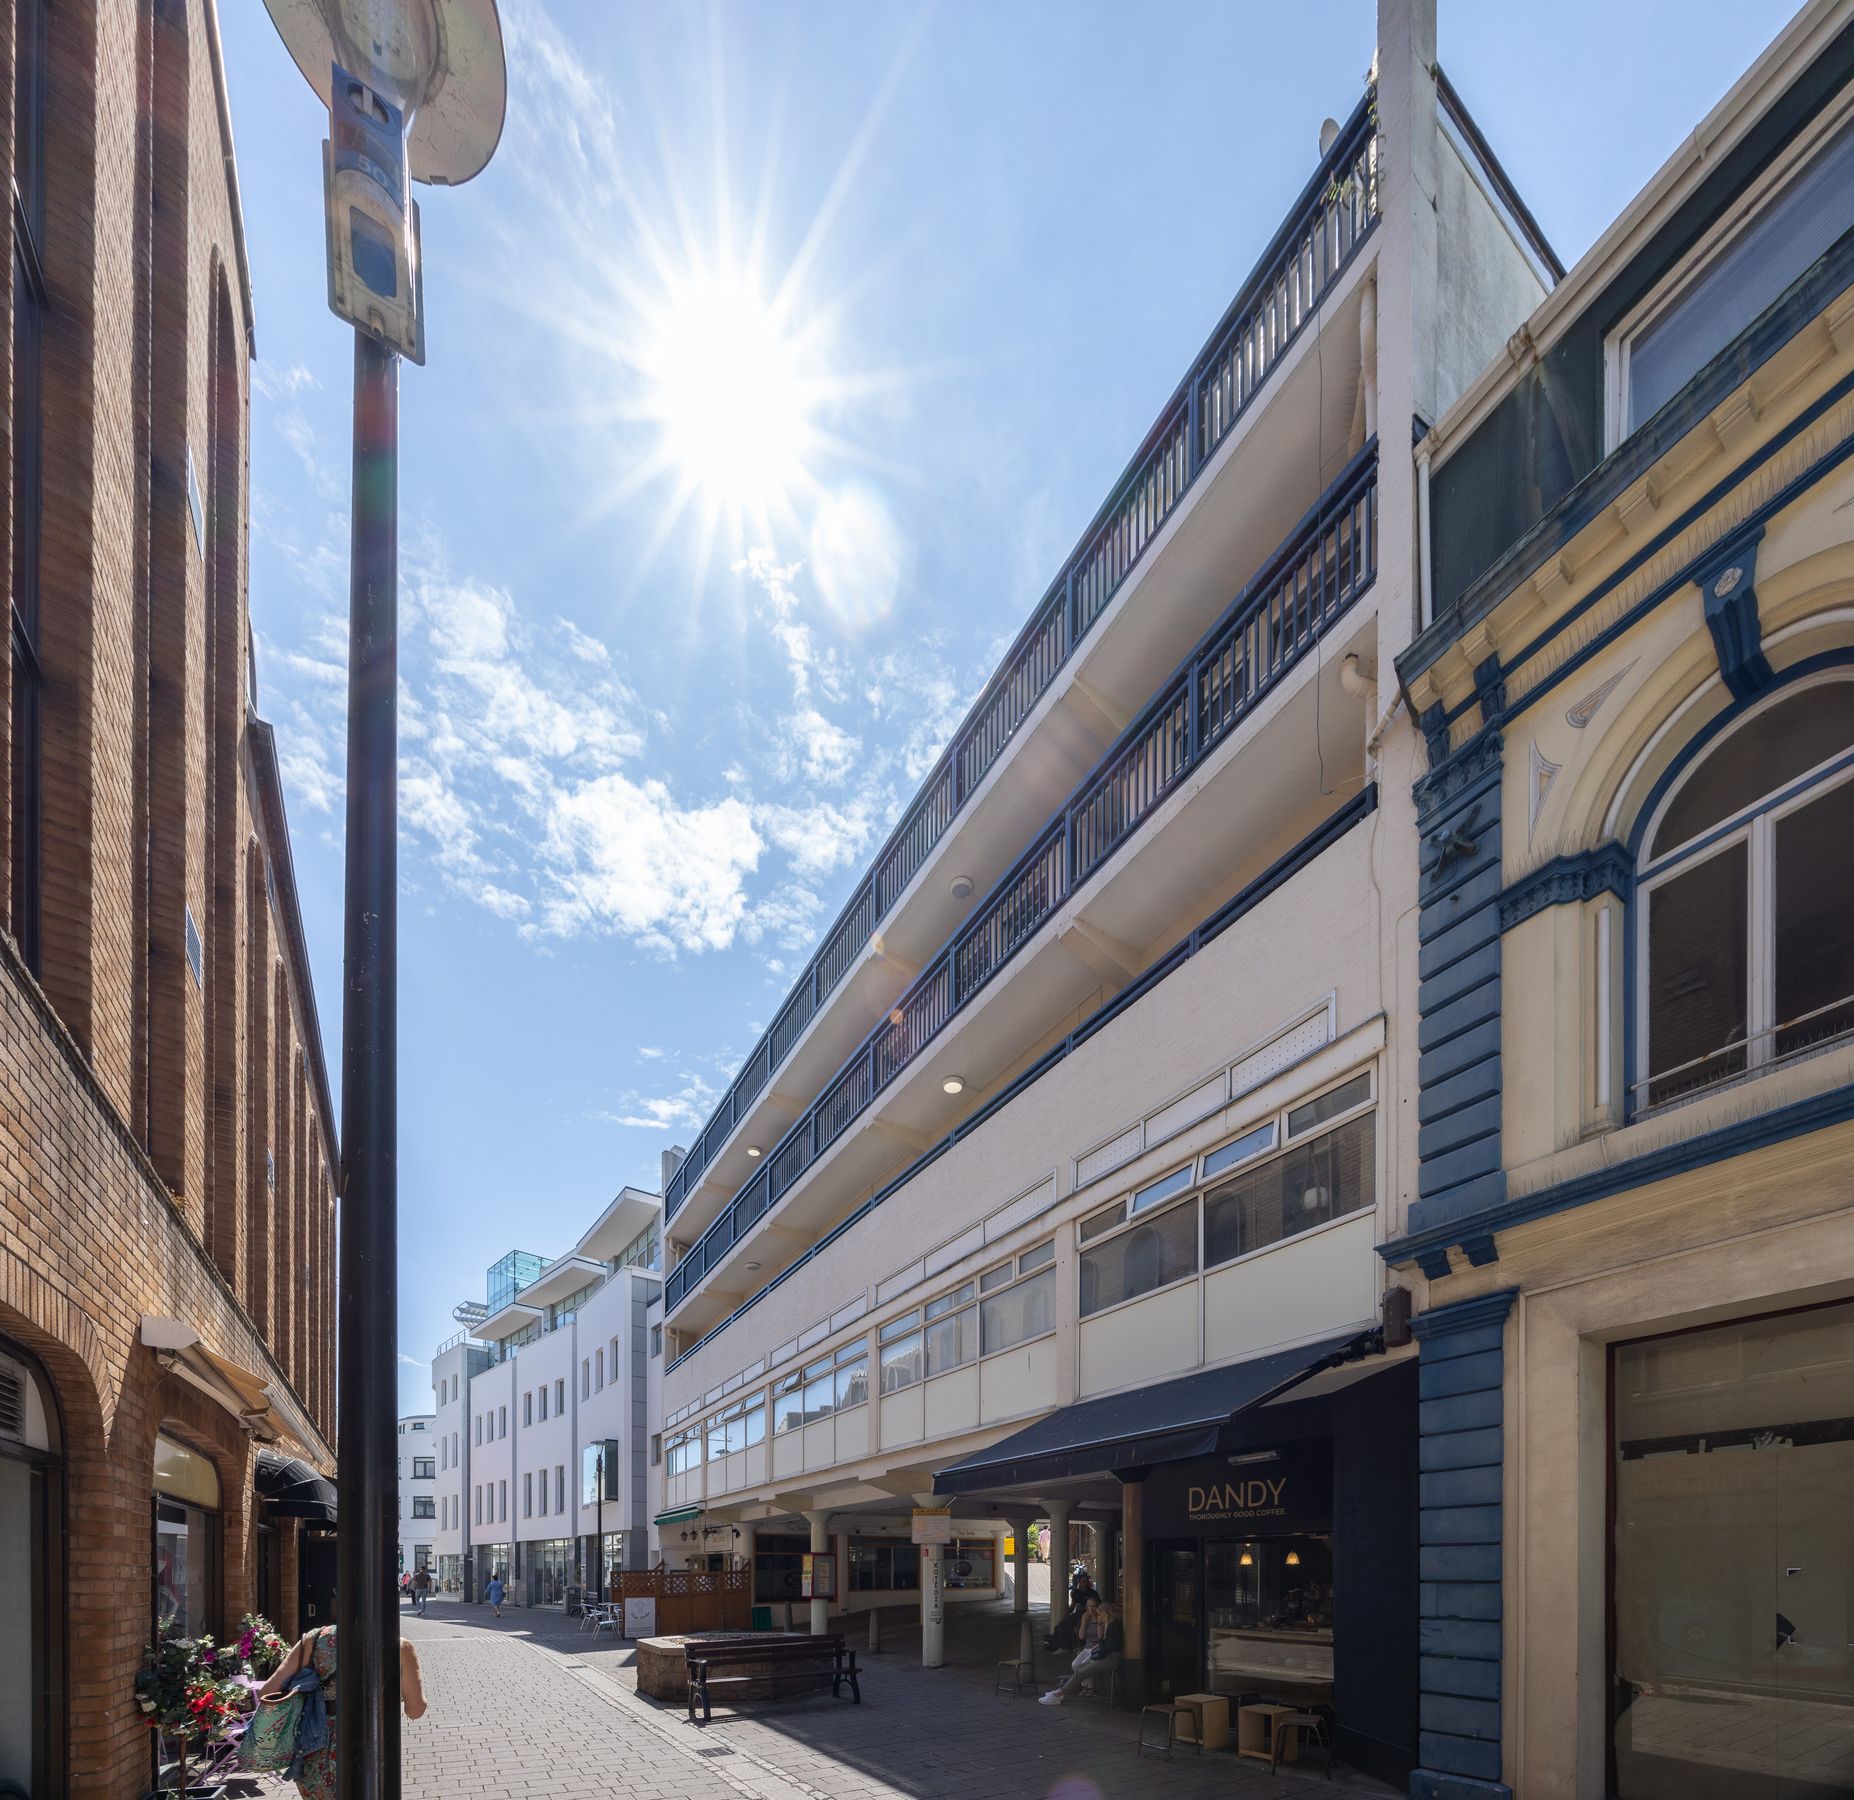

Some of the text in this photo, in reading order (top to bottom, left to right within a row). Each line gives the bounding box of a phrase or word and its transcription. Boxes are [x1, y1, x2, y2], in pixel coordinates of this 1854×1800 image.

[1188, 1477, 1286, 1511] DANDY
[1189, 1512, 1232, 1521] THOROUGHLY
[1234, 1510, 1255, 1518] GOOD
